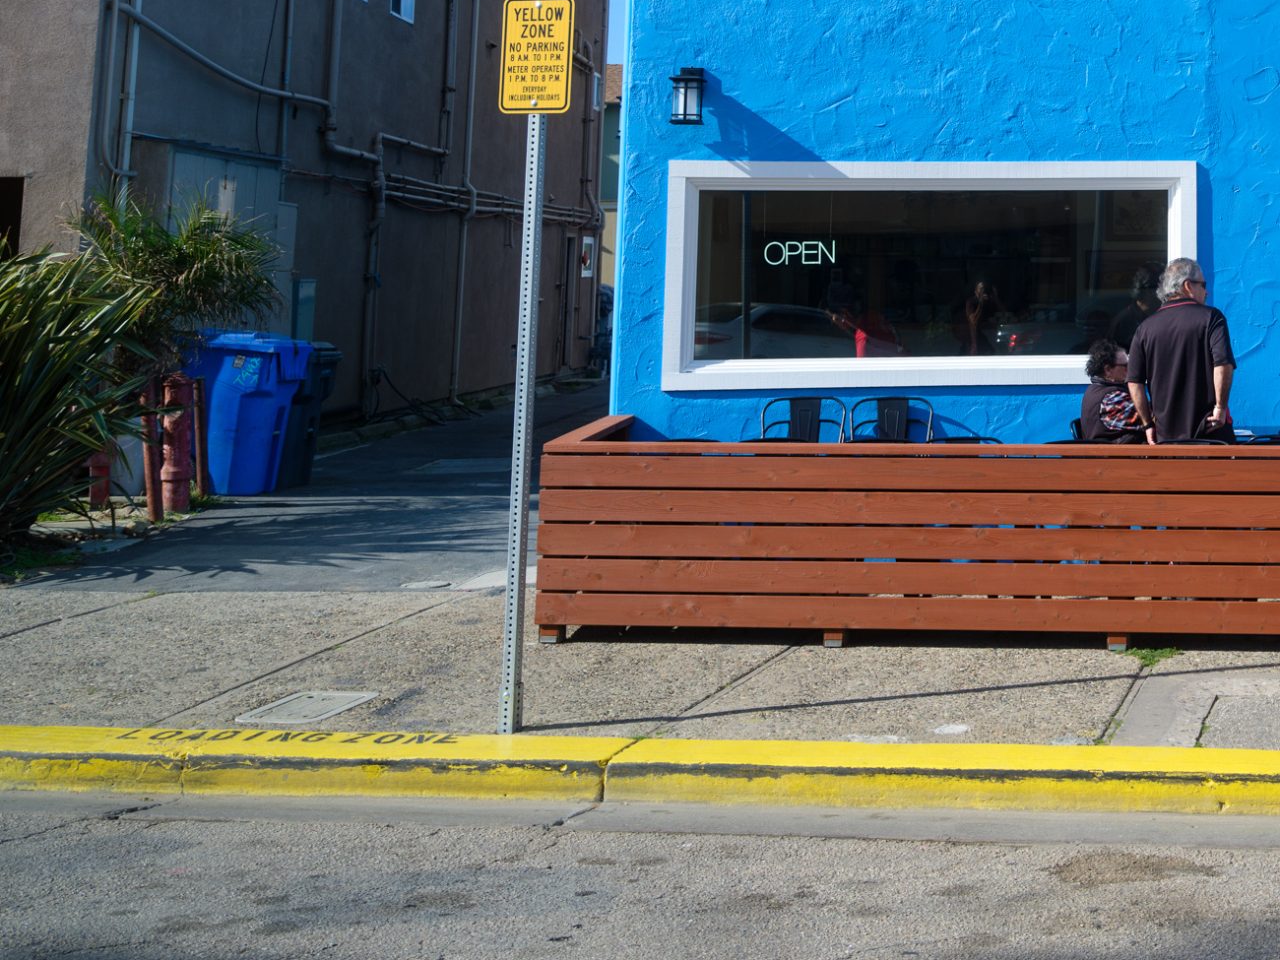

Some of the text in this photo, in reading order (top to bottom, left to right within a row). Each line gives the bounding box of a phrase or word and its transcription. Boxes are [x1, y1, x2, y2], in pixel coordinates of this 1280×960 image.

[514, 7, 564, 22] YELLOW
[520, 24, 555, 39] ZONE
[509, 41, 565, 53] NO PARKING
[510, 53, 515, 61] 8
[507, 65, 564, 74] METER OPERATES
[530, 74, 538, 82] TO
[764, 240, 835, 265] OPEN
[116, 729, 459, 744] LOADING ZONE
